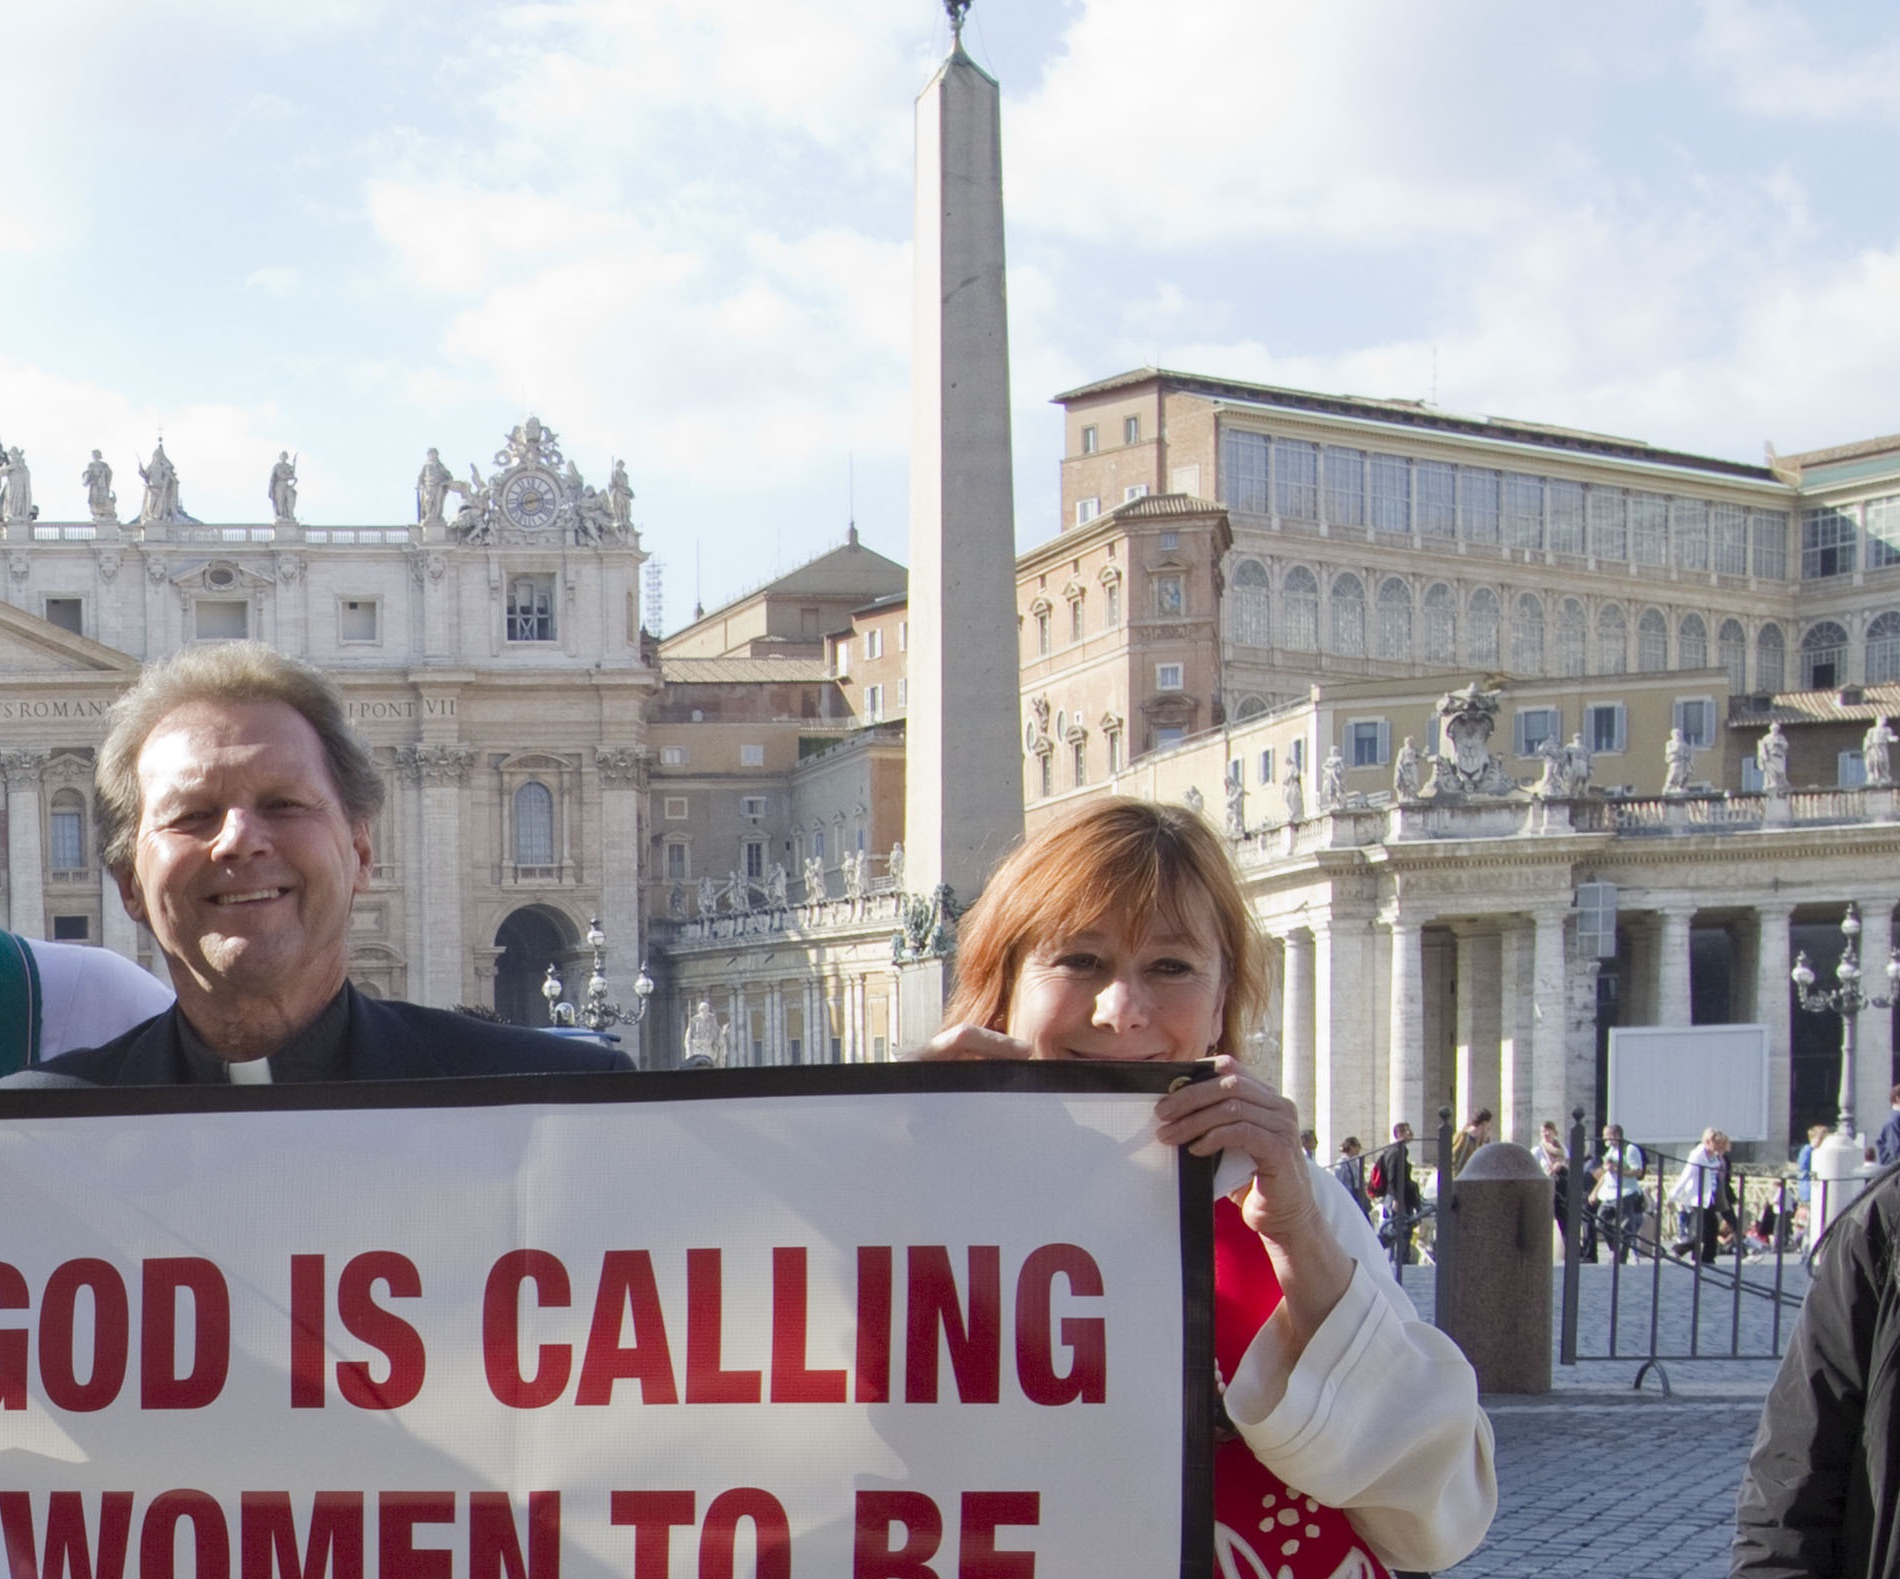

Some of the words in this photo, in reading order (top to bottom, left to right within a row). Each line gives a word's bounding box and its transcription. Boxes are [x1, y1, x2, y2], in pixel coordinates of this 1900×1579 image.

[19, 701, 112, 718] ROMAN
[360, 702, 414, 718] PONT
[426, 700, 456, 715] VII
[291, 1251, 426, 1410] IS
[482, 1244, 1106, 1409] CALLING
